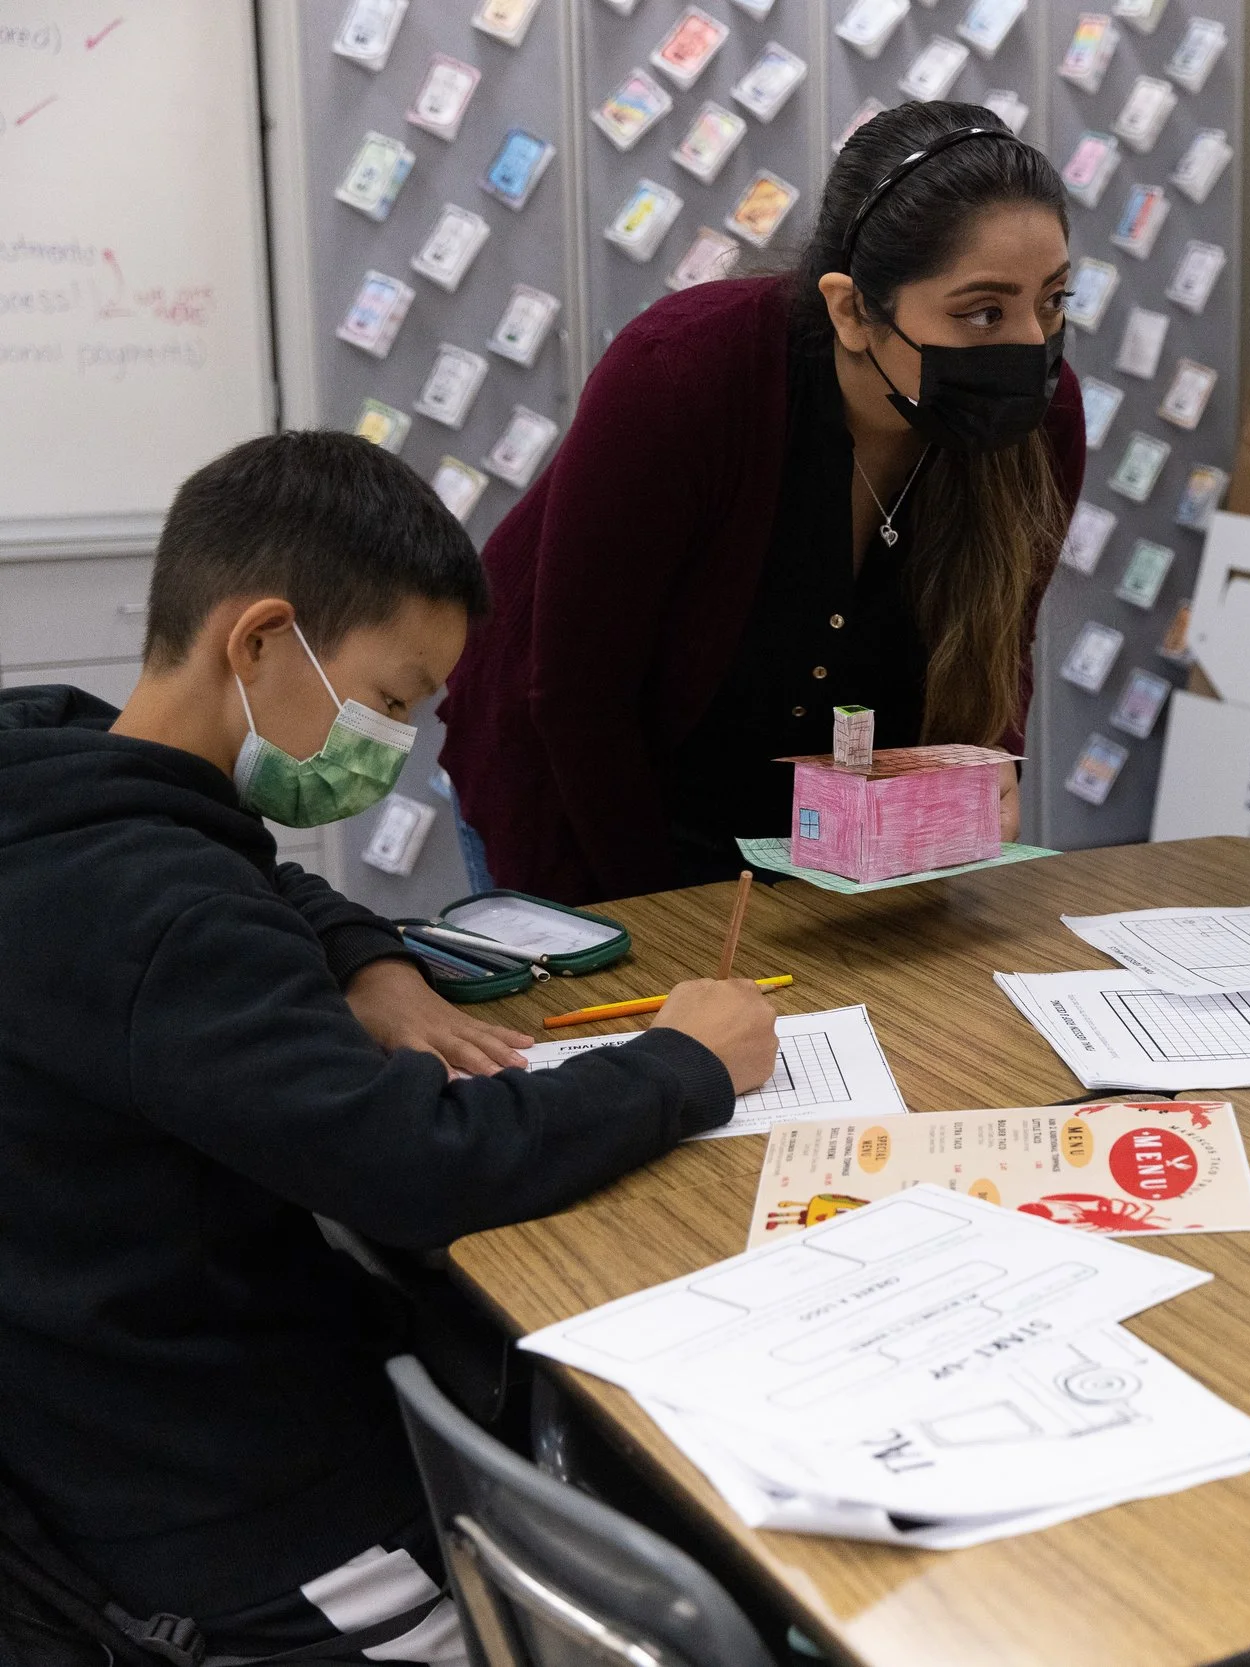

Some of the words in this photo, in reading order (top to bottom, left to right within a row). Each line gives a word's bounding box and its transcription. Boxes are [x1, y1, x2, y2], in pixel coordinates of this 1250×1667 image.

[861, 1140, 872, 1157] MENU
[875, 1135, 888, 1161] SPECIAL
[1067, 1126, 1085, 1156] MENU
[1132, 1135, 1169, 1190] MENU
